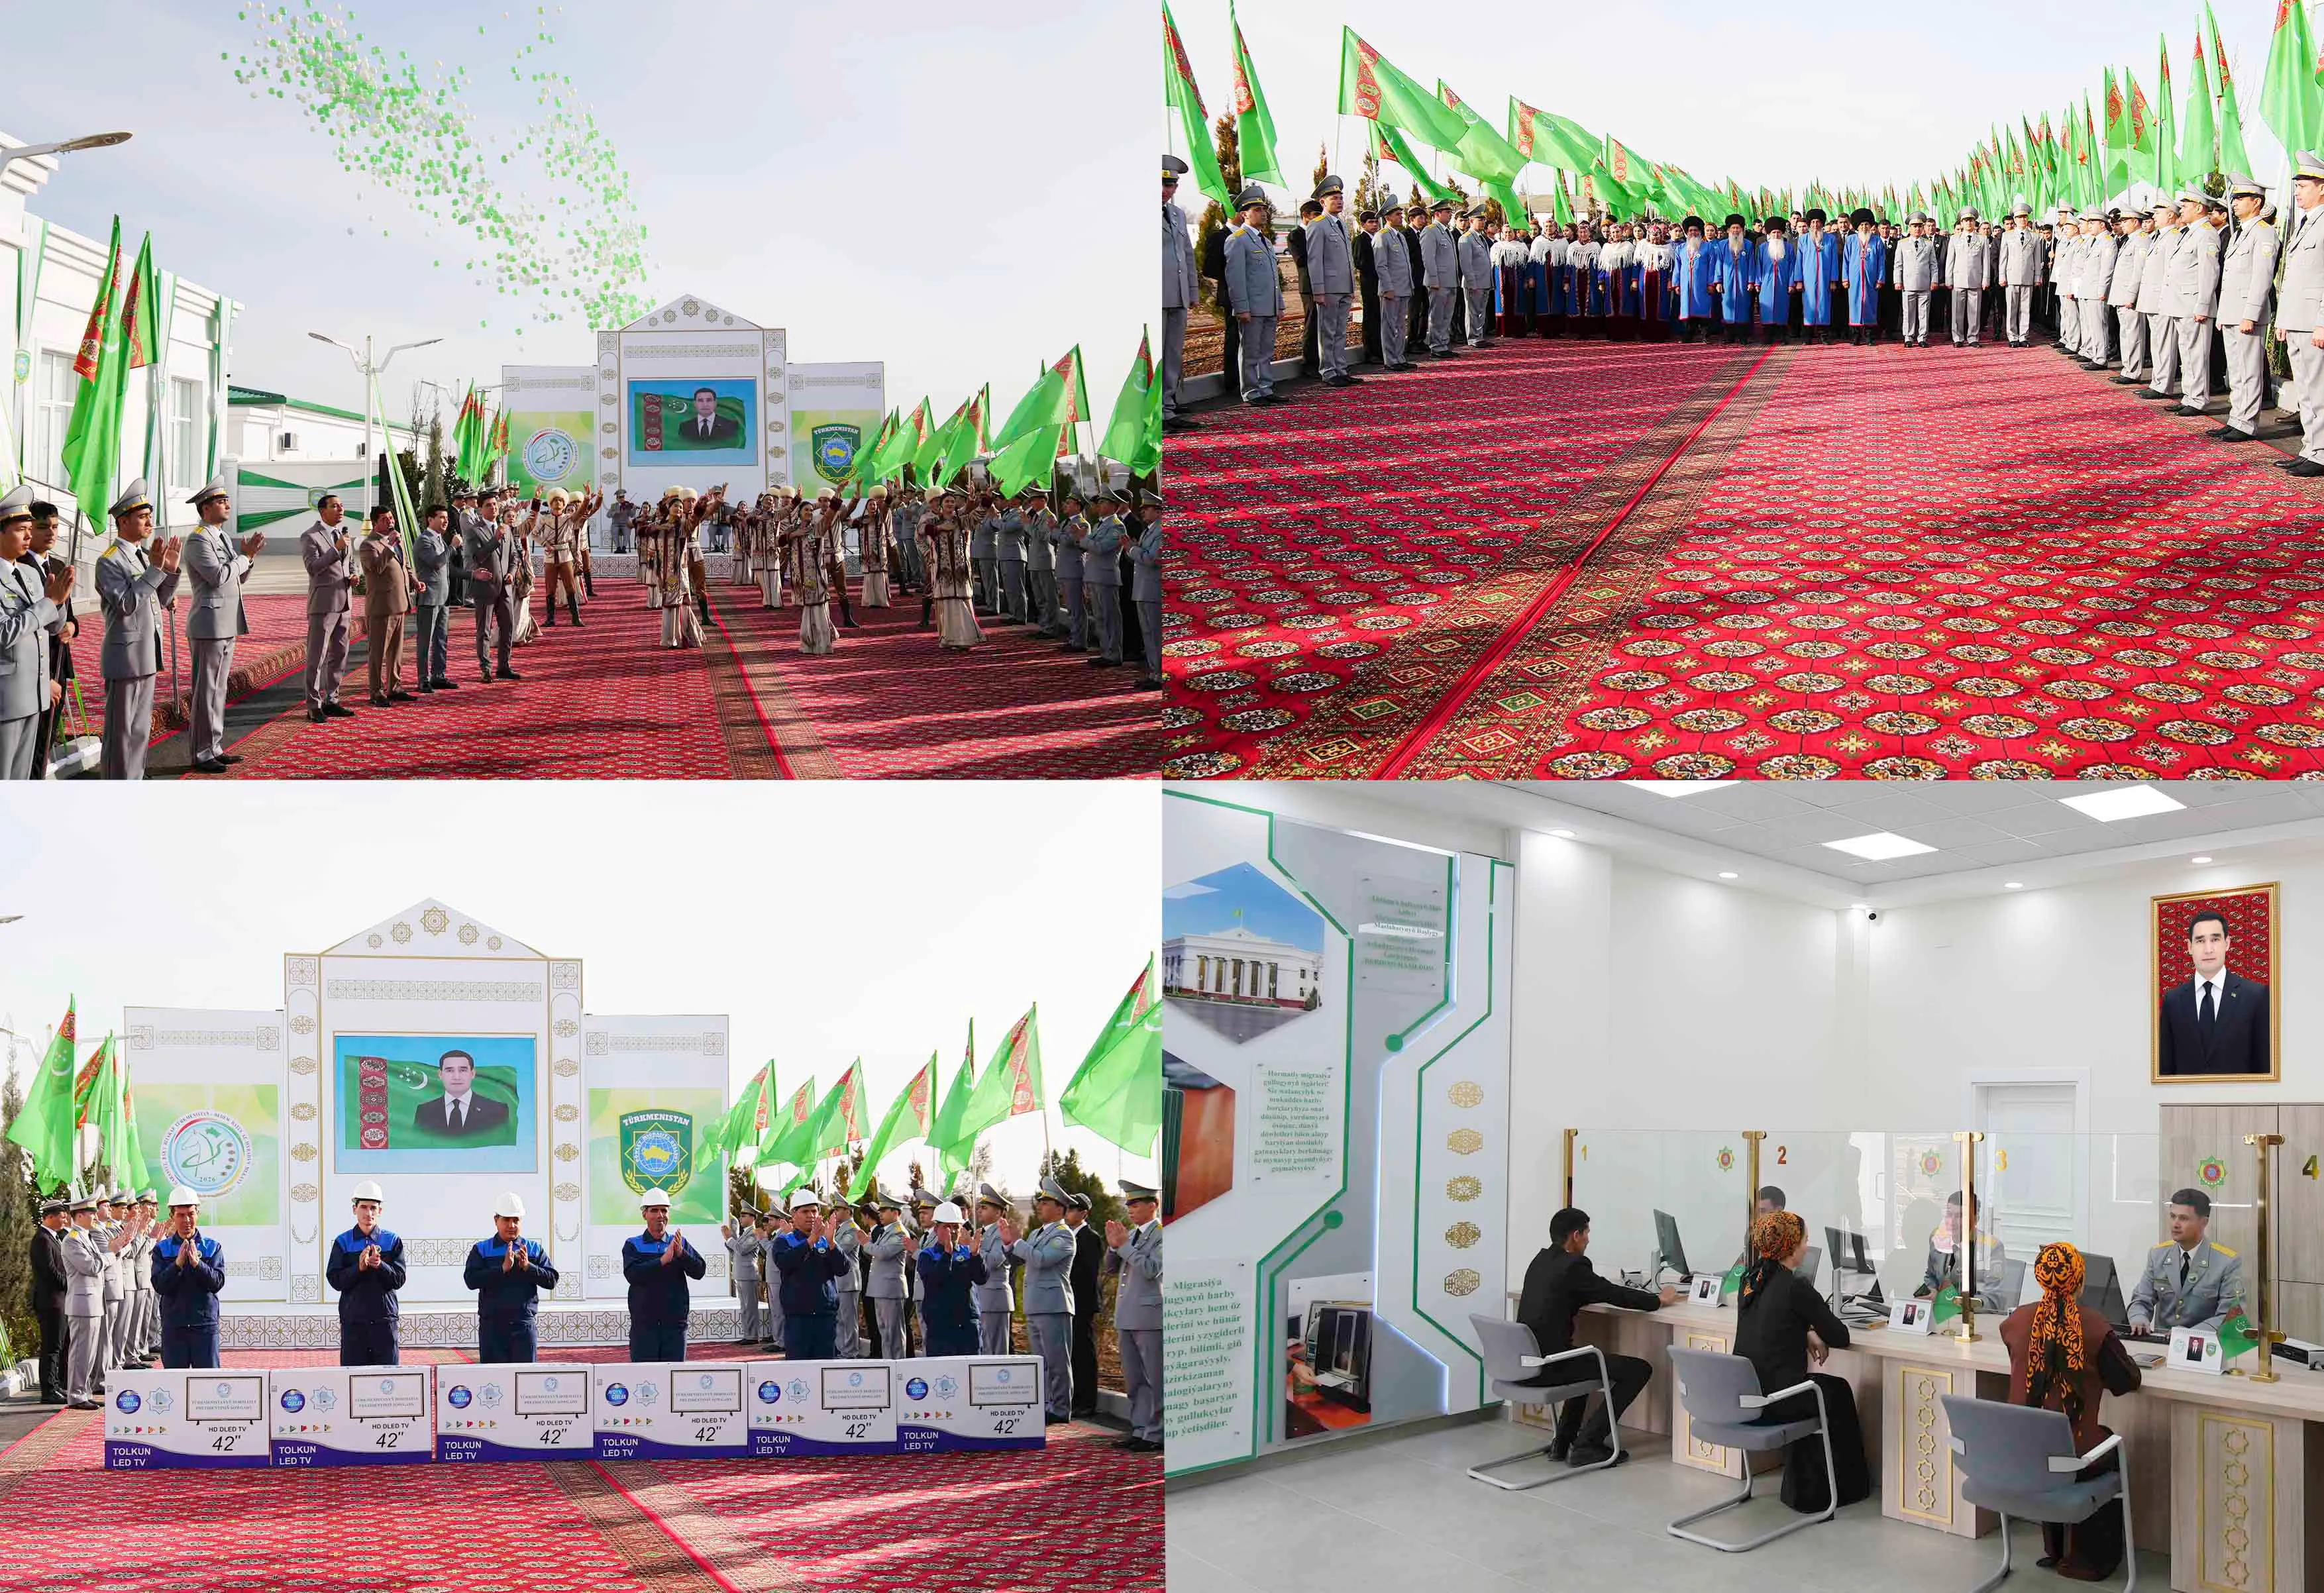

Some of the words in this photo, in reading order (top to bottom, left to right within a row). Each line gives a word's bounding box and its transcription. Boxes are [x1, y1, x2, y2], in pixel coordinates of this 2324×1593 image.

[623, 1113, 690, 1126] TÜRKMENISTAN
[1777, 1145, 1787, 1164] 2
[1995, 1150, 2007, 1171] 3
[2302, 1155, 2319, 1180] 4
[1174, 1278, 1222, 1291] Migrasiýa
[1208, 1290, 1235, 1300] harby
[1213, 1315, 1241, 1325] hünär
[280, 1446, 316, 1455] TOLKUN
